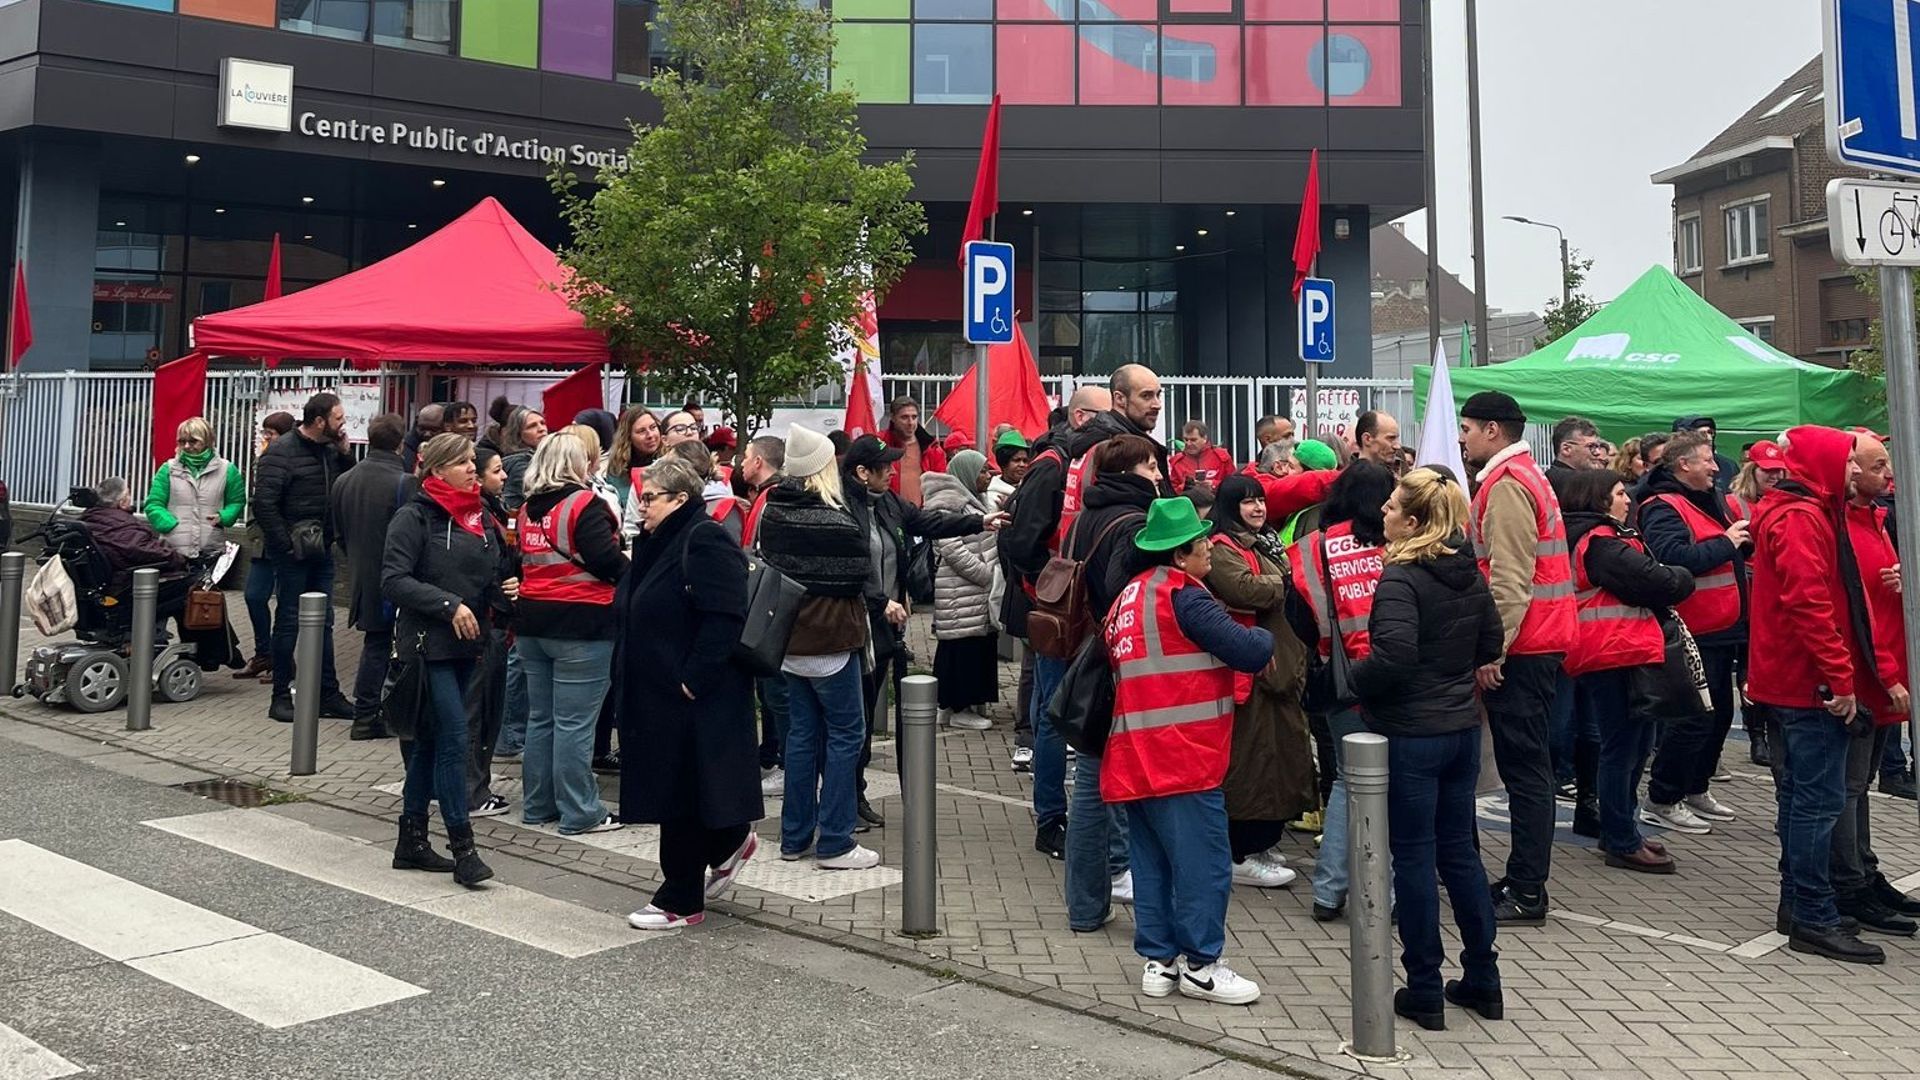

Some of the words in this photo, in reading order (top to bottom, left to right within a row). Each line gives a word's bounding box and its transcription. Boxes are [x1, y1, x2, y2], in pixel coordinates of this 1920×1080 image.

[231, 88, 243, 98] LA
[300, 112, 385, 143] Centre
[391, 123, 468, 152] Public
[570, 144, 629, 172] Socia
[974, 254, 1006, 323] P
[1306, 289, 1329, 346] P
[1295, 389, 1359, 406] ARÊTER
[1329, 537, 1368, 554] CGS
[1328, 555, 1383, 580] SERVICES
[1338, 579, 1377, 602] PUBLIC
